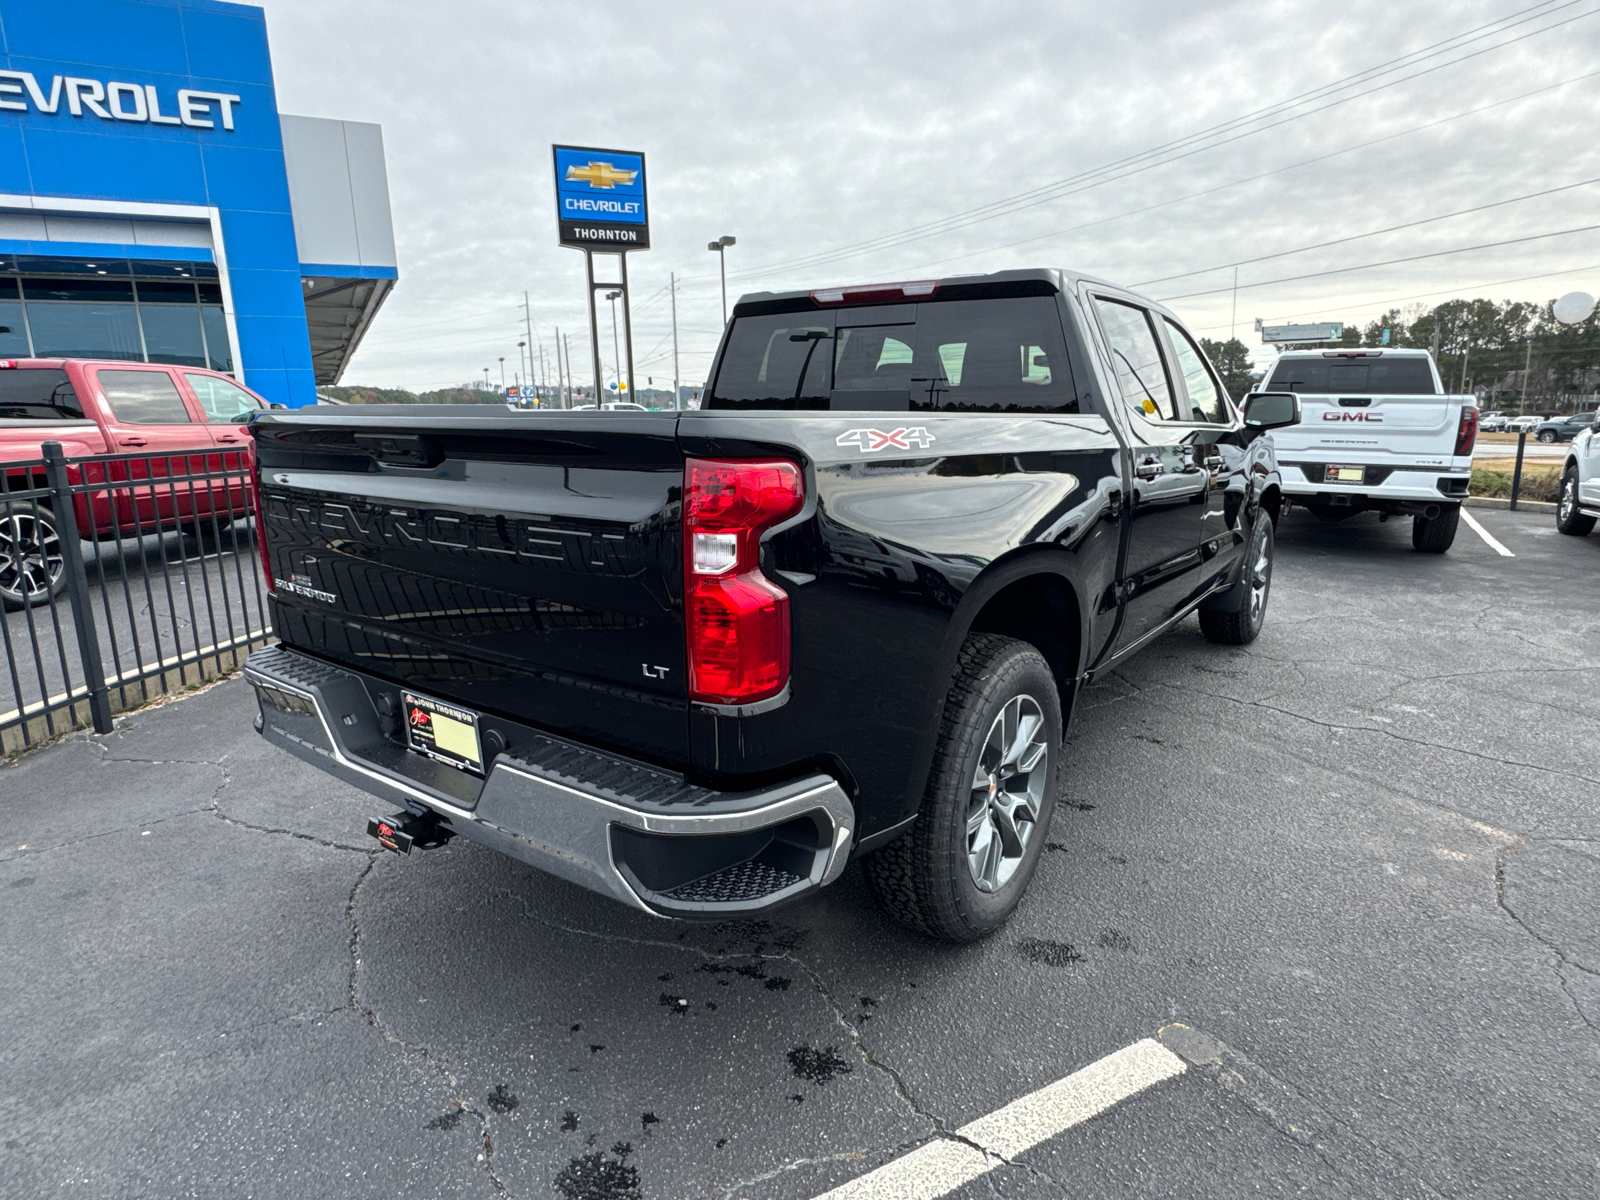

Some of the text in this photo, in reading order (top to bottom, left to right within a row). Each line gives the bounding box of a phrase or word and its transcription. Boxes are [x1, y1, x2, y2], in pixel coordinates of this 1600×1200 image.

[565, 198, 640, 214] CHEVROLET
[574, 228, 637, 241] THORNTON
[1322, 411, 1384, 422] GMC
[268, 494, 626, 566] CHEVROLET
[274, 578, 337, 603] SILVERADO
[642, 663, 670, 680] LT
[417, 698, 436, 710] JOHN
